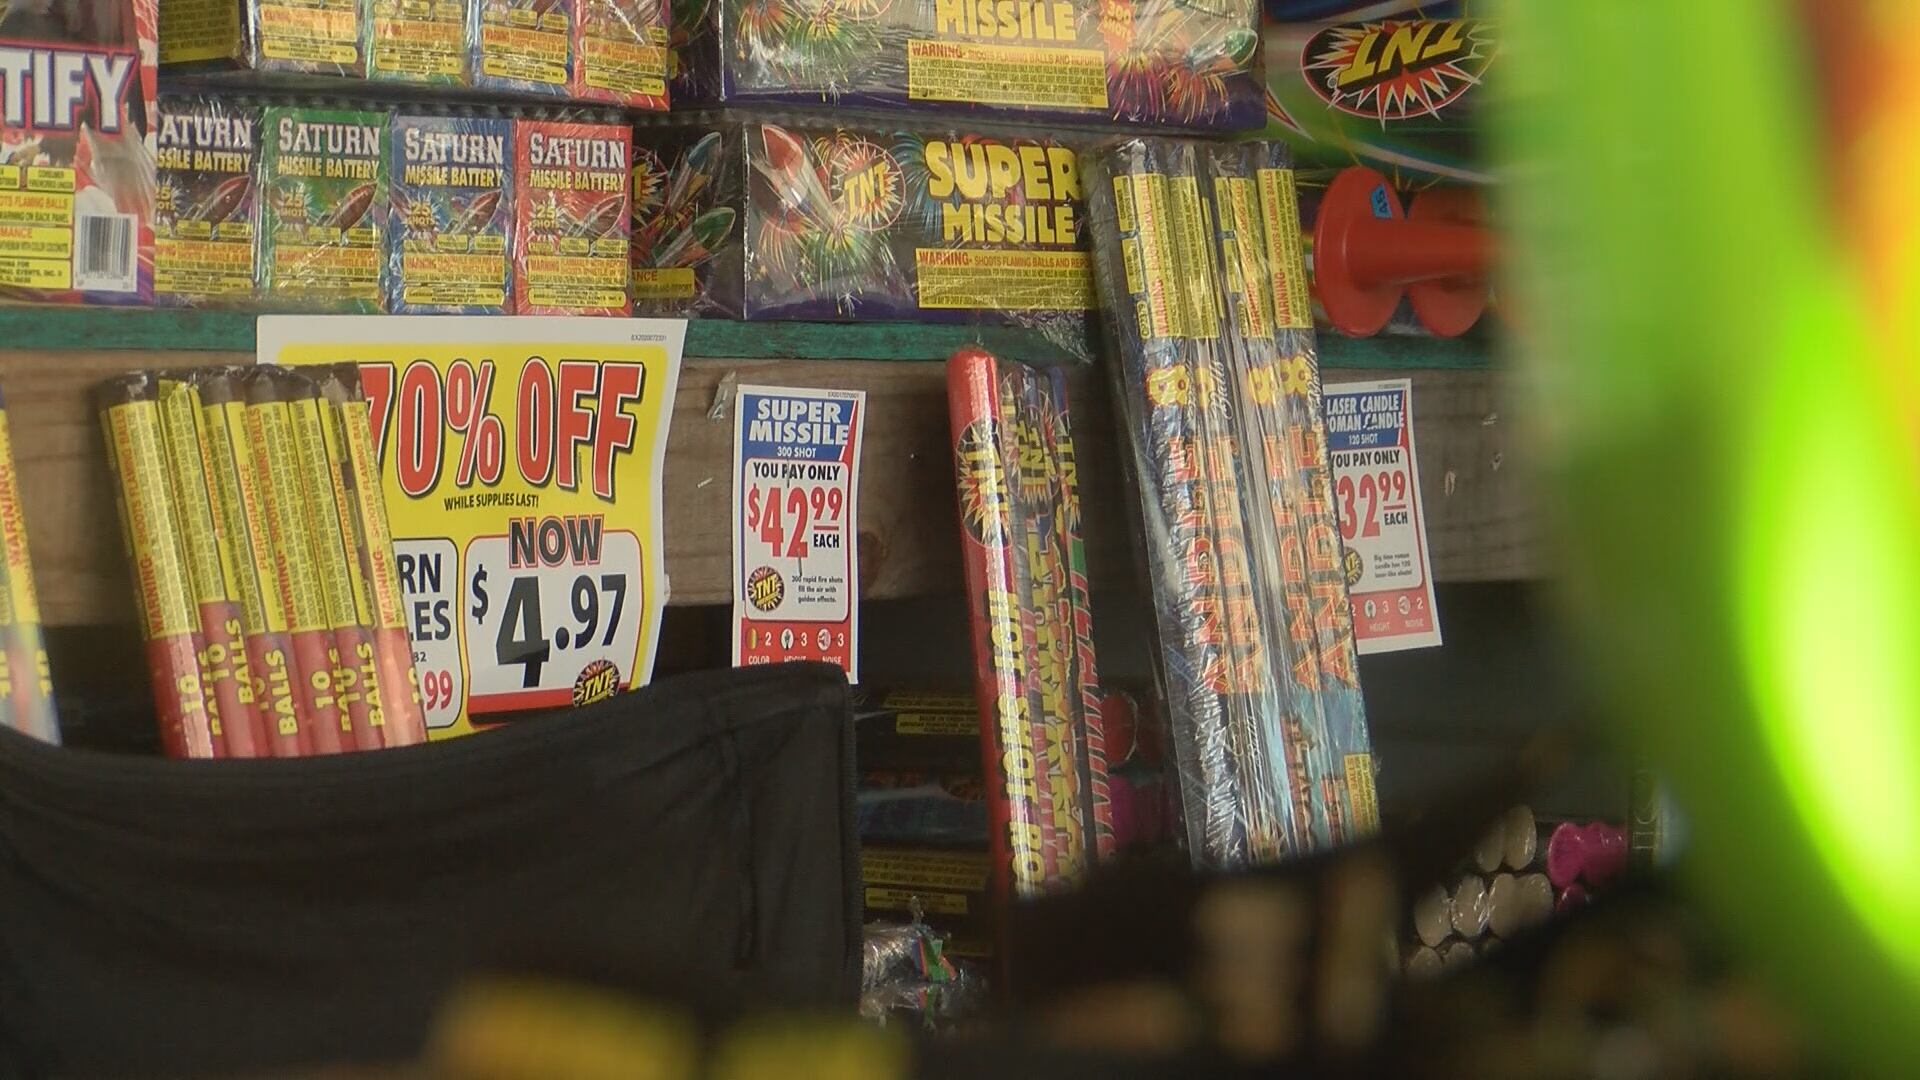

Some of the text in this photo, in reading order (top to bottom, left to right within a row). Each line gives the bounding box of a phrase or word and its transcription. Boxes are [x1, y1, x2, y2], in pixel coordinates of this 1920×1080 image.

[936, 0, 1077, 41] MISSILE
[1055, 54, 1070, 65] AND
[1337, 21, 1464, 88] TNT
[159, 115, 251, 149] ATURN
[279, 117, 380, 155] SATURN
[405, 127, 504, 165] SATURN
[530, 132, 626, 168] SATURN
[158, 147, 252, 173] SSILE BATTERY
[278, 156, 380, 180] MISSILE BATTERY
[924, 141, 1082, 201] SUPER
[405, 165, 503, 188] MISSILE BATTERY
[529, 170, 626, 193] MISSILE BATTERY
[844, 161, 891, 215] TNT
[1263, 171, 1275, 195] BALLS
[157, 201, 176, 210] OTS
[286, 193, 303, 206] 25
[411, 203, 430, 215] 25
[536, 205, 554, 218] 25
[943, 203, 1076, 244] MISSILE
[919, 251, 1089, 268] WARNING- SHOOTS FLAMING BALLS AND REPO
[1272, 268, 1292, 325] WARNING-
[757, 398, 841, 424] SUPER
[1327, 394, 1399, 415] LASER CANDLE
[358, 358, 505, 497] 70%
[515, 355, 645, 500] OFF
[748, 420, 850, 446] MISSILE
[1327, 414, 1361, 432] OMAN
[777, 446, 817, 458] 300 SHOT
[1348, 433, 1378, 445] 120 SHOT
[753, 462, 841, 480] YOU PAY ONLY
[1330, 449, 1400, 468] YOU PAY ONLY
[1379, 470, 1406, 501] 99
[348, 404, 394, 624] WARNING- SHOOTS FLAMING BALLS
[444, 493, 539, 511] WHILE SUPPLIES LAST!
[810, 485, 843, 521] 99
[113, 409, 164, 633] WARNING- SHOOTS FLAMING BALLS
[240, 462, 267, 570] PERFORMANCE
[247, 407, 297, 628] WARNING- SHOOTS FLAMING BALLS
[1384, 511, 1409, 526] EACH
[508, 514, 605, 569] NOW
[813, 533, 840, 549] EACH
[755, 573, 777, 599] TNT
[1382, 600, 1389, 614] 3
[1416, 597, 1423, 610] 2
[765, 631, 772, 646] 2
[800, 632, 808, 647] 3
[837, 632, 844, 647] 3
[985, 586, 1025, 678] HOT
[205, 641, 231, 680] 10
[222, 617, 256, 704] BALLS
[748, 655, 770, 665] COLOR
[176, 672, 203, 713] 10
[262, 648, 299, 735] BALLS
[309, 668, 336, 708] 10
[353, 640, 388, 727] BALLS
[582, 668, 612, 700] TNT
[993, 690, 1041, 811] SHOT
